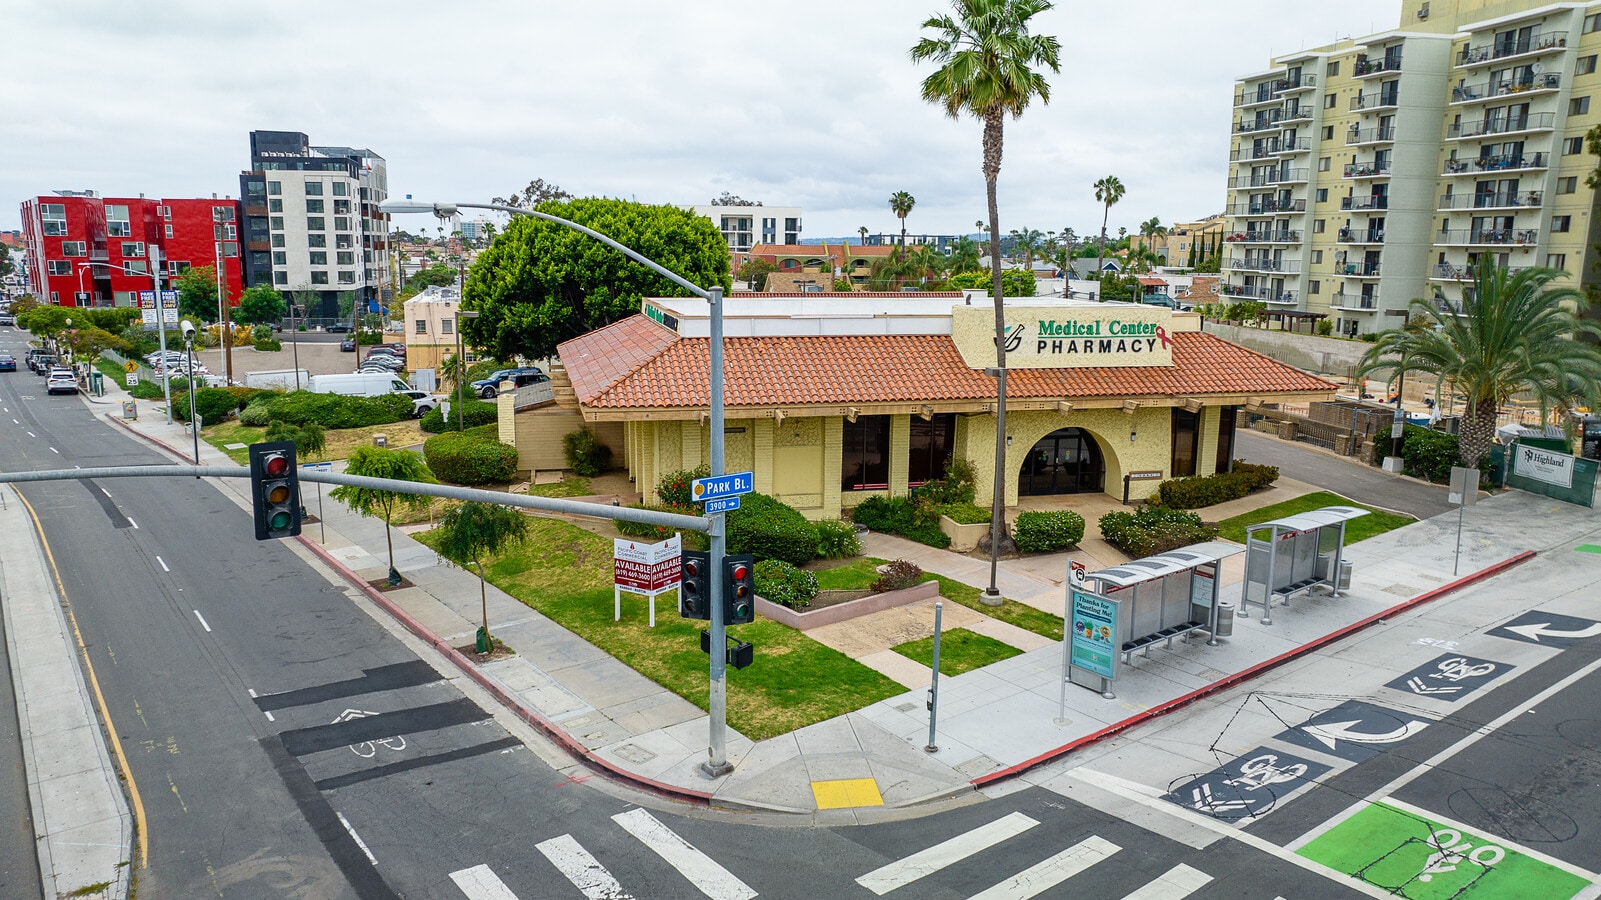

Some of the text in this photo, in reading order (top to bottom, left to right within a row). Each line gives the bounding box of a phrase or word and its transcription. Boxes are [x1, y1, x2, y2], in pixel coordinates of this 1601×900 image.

[1038, 320, 1157, 336] Medical Center
[1037, 338, 1157, 354] PHARMACY
[1534, 454, 1564, 467] Highland
[708, 478, 749, 494] PARK BL.
[710, 501, 726, 510] 3900
[618, 551, 647, 560] COMMERCIAL
[615, 560, 650, 573] AVAILABLE
[653, 557, 681, 573] AVAILABLE
[629, 571, 650, 580] 469-3600
[1079, 596, 1099, 607] Thanks
[1076, 602, 1100, 615] Planting
